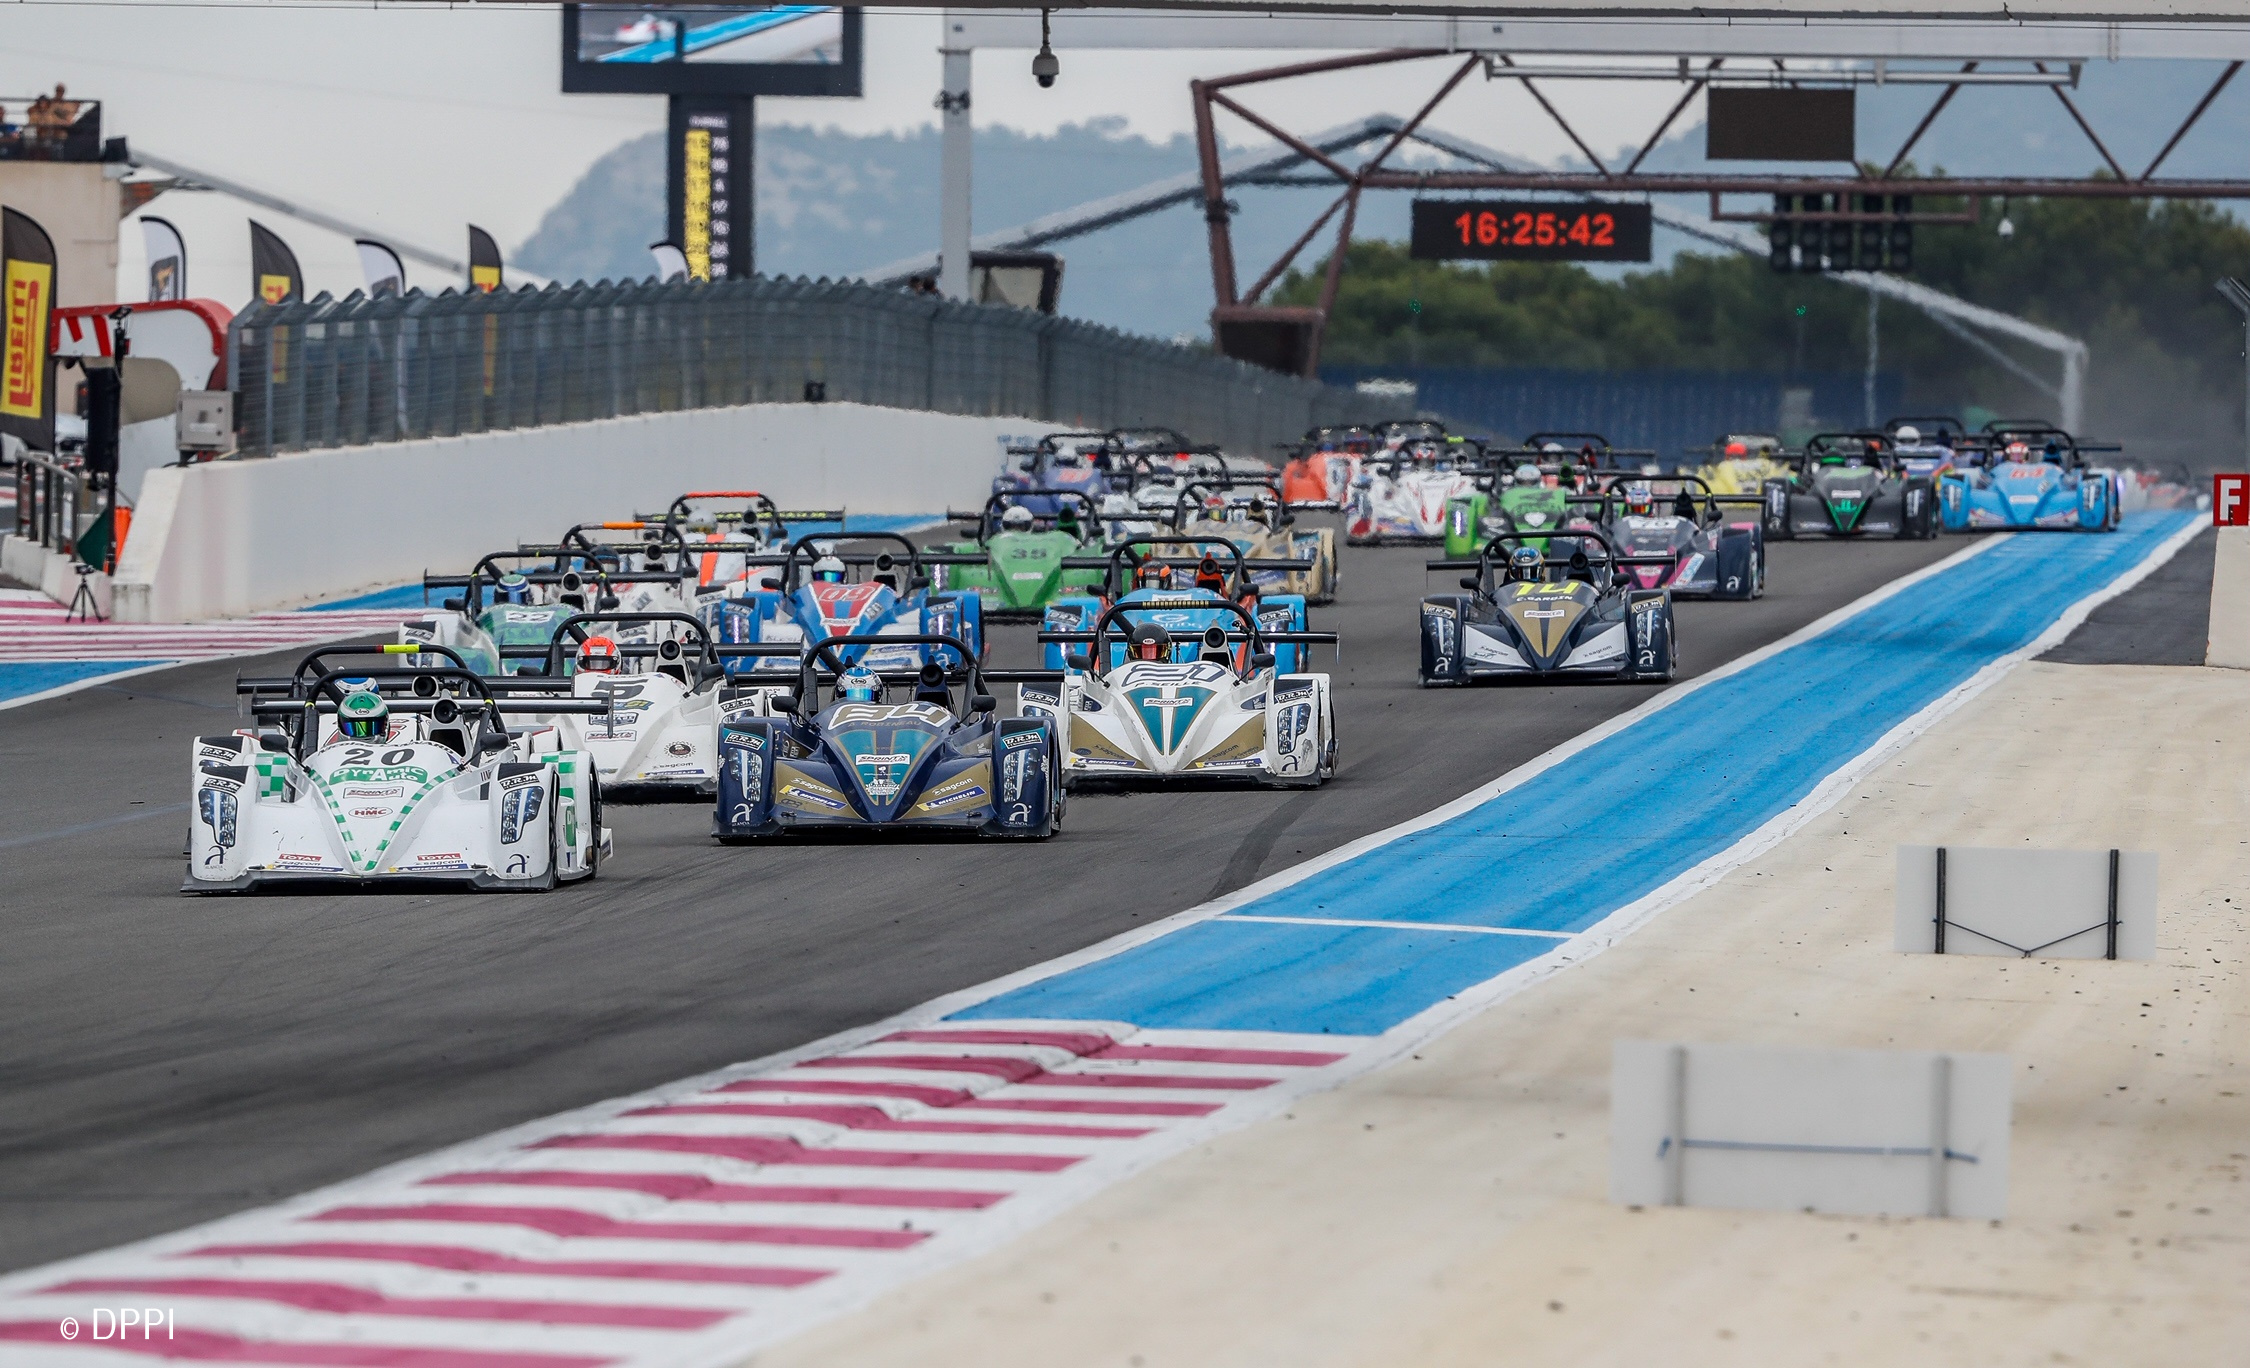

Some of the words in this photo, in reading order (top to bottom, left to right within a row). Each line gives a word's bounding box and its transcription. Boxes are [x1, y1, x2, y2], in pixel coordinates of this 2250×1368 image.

[1454, 211, 1616, 247] 16:25:42
[2220, 479, 2242, 521] F
[1516, 581, 1579, 597] 14
[507, 612, 549, 622] 22
[340, 748, 415, 766] 20
[938, 790, 976, 805] MICHELIN
[355, 808, 387, 816] HMC
